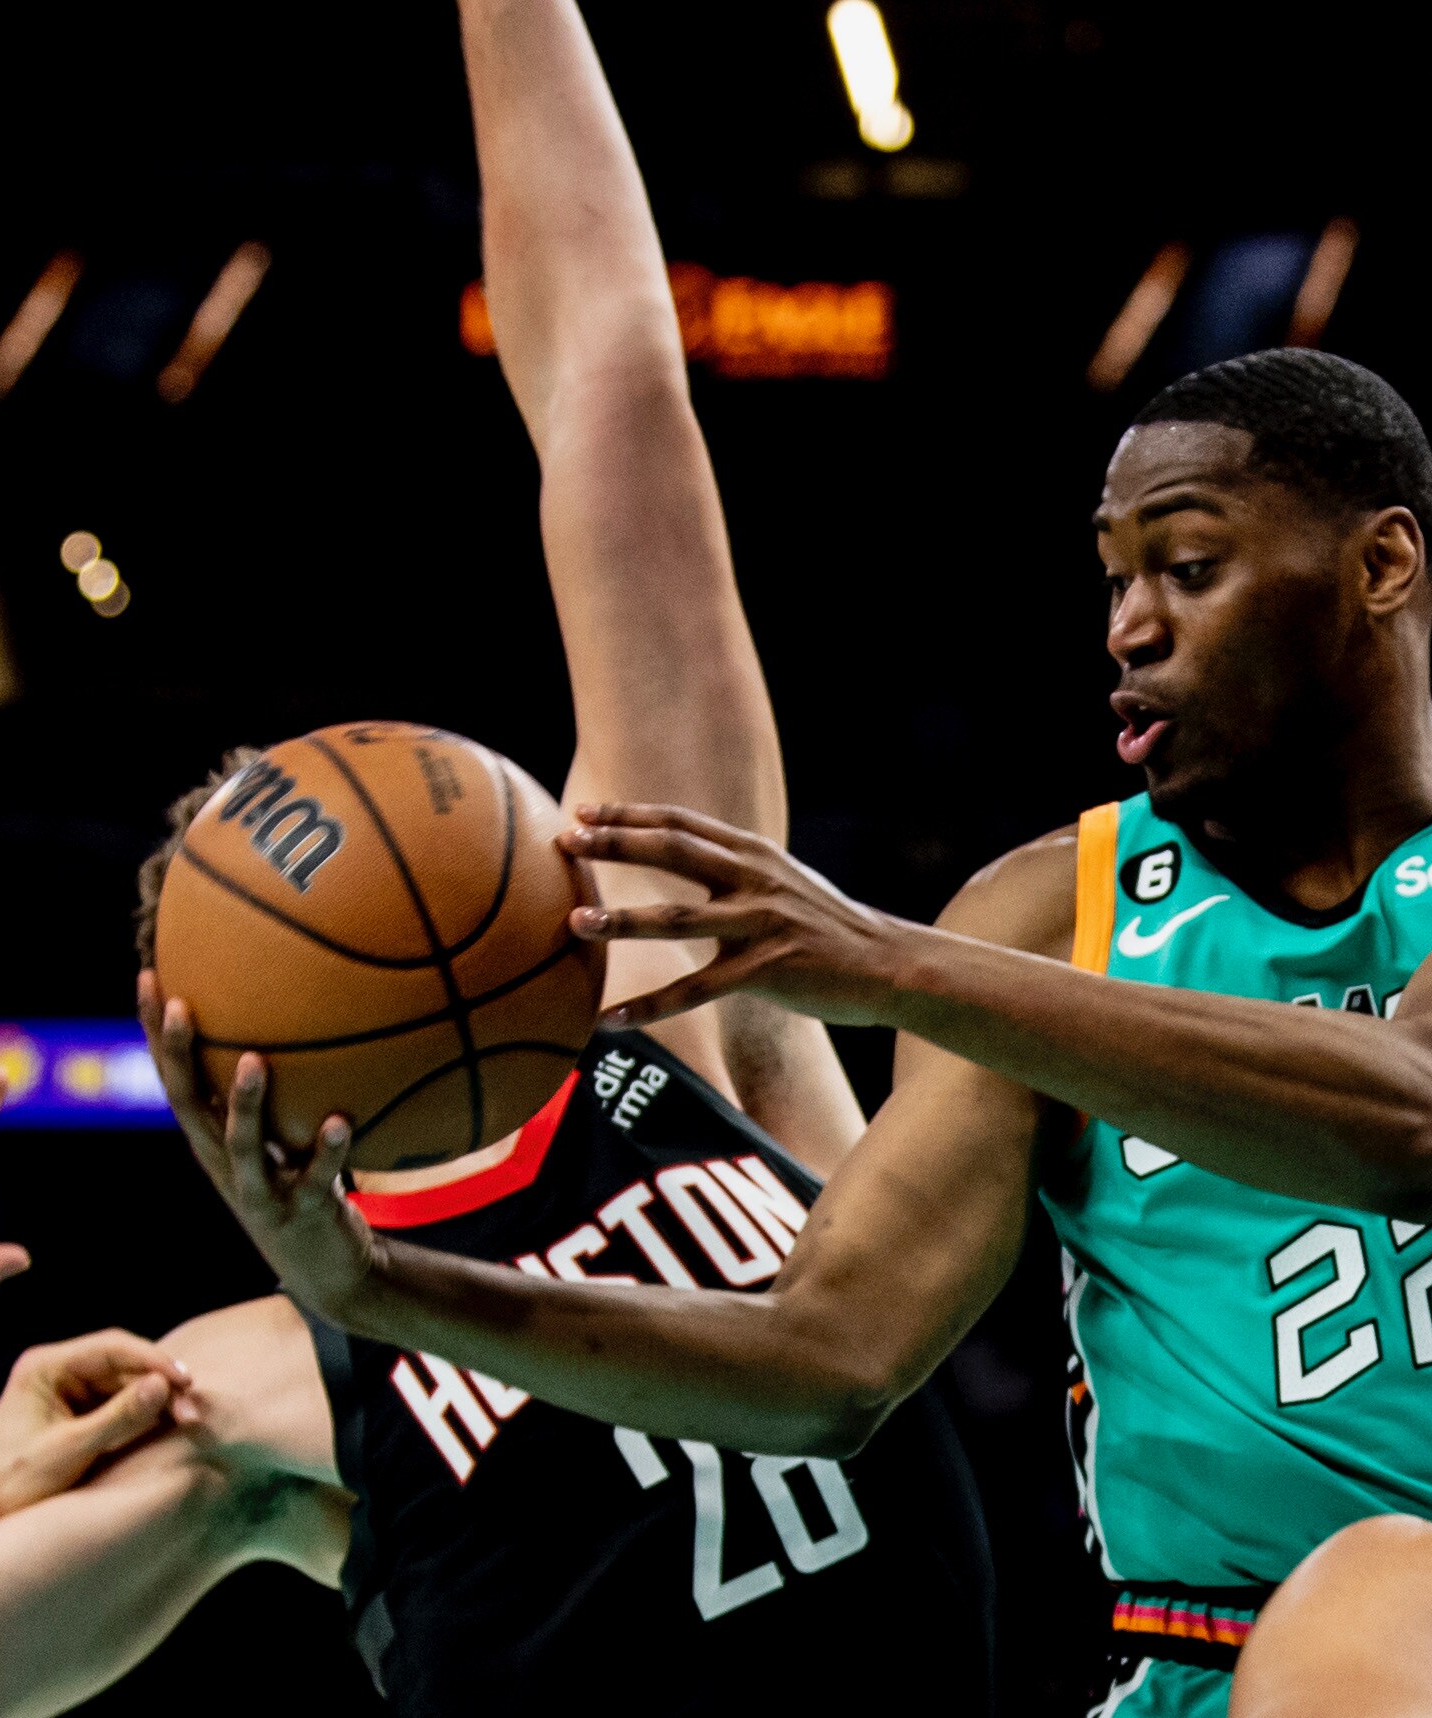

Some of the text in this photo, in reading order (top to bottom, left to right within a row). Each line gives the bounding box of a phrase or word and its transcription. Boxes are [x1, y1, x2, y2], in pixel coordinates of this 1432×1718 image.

[1135, 849, 1174, 900] 6
[592, 1049, 636, 1109] dit
[390, 1155, 809, 1485] HSTON
